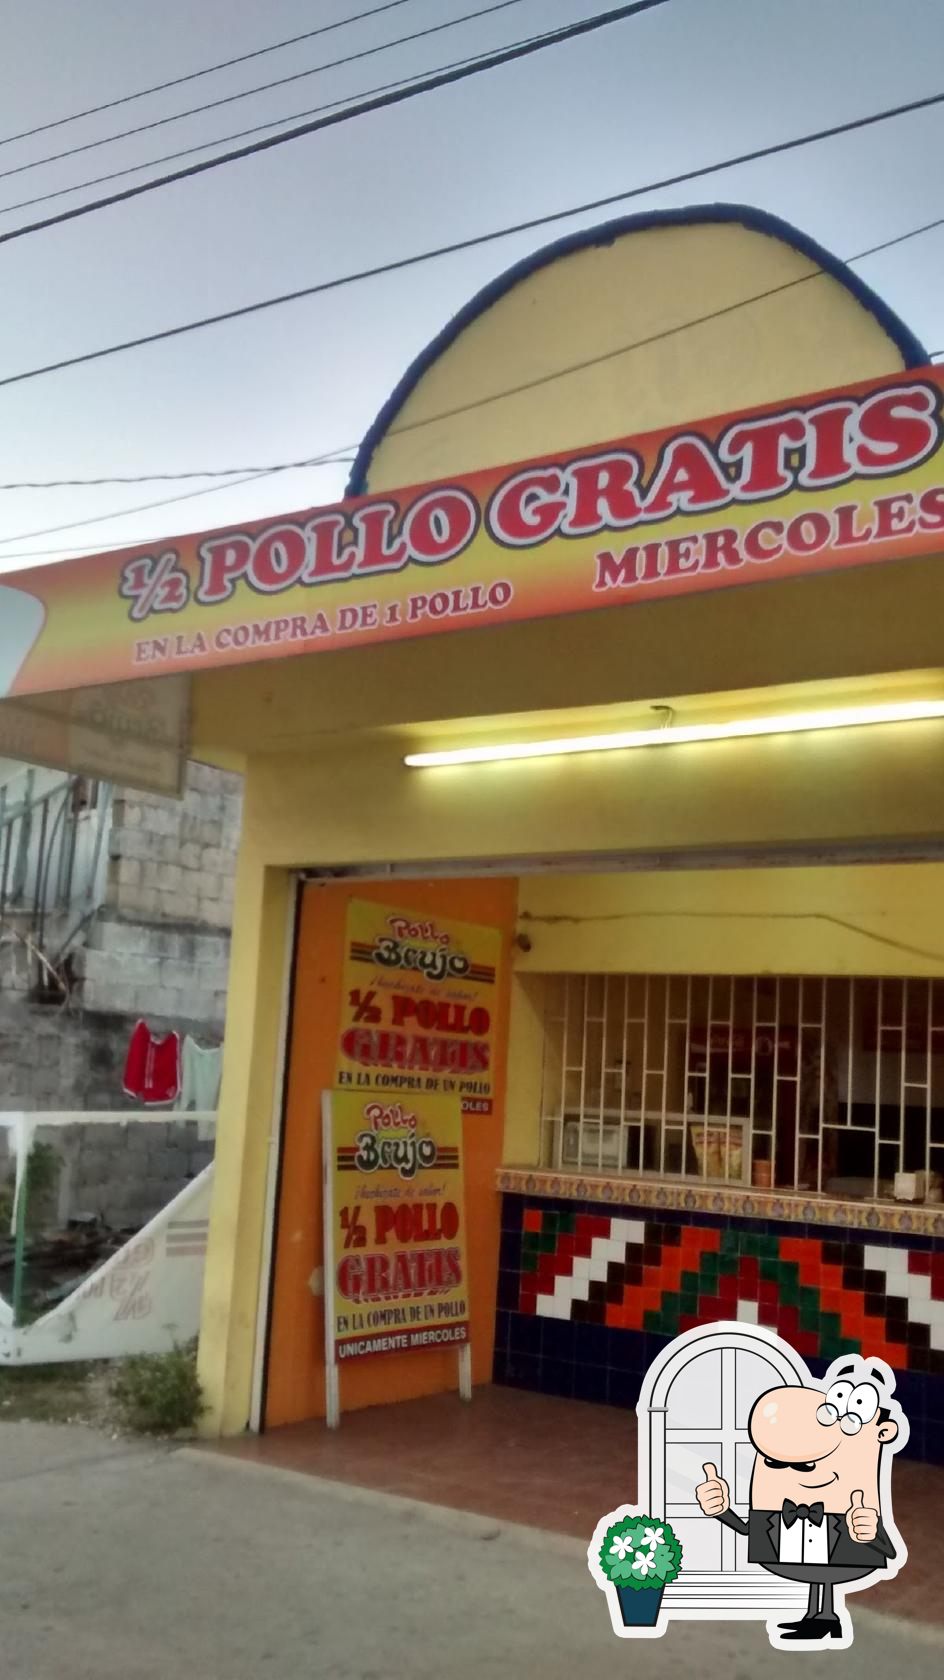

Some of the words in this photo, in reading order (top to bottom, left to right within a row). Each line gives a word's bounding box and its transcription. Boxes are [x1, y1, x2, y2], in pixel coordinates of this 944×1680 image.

[198, 493, 481, 604] POLLO
[488, 384, 940, 546] GRATIS
[593, 487, 944, 591] MIERCOLES
[134, 637, 169, 664] EN
[174, 632, 208, 656] LA
[214, 611, 329, 651] COMPRA
[337, 602, 377, 631] DE
[385, 602, 401, 626] 1
[407, 580, 514, 621] POLLO
[372, 936, 471, 983] Brujo
[391, 995, 490, 1036] POLLO
[341, 1028, 490, 1075] GRATIS
[338, 1071, 352, 1085] EN
[357, 1072, 370, 1087] LA
[375, 1073, 421, 1090] COMPRA
[425, 1078, 439, 1092] DE
[459, 1081, 490, 1095] POLLO
[354, 1130, 437, 1180] Brujo
[374, 1202, 459, 1245] POLLO
[337, 1247, 462, 1304] GRATIS
[337, 1315, 349, 1332] EN
[352, 1313, 364, 1330] LA
[367, 1308, 406, 1327] COMPRA
[410, 1305, 421, 1322] DE
[438, 1300, 466, 1318] POLLO
[338, 1335, 408, 1358] UNICAMENTE
[411, 1327, 466, 1346] MIERCOLES
